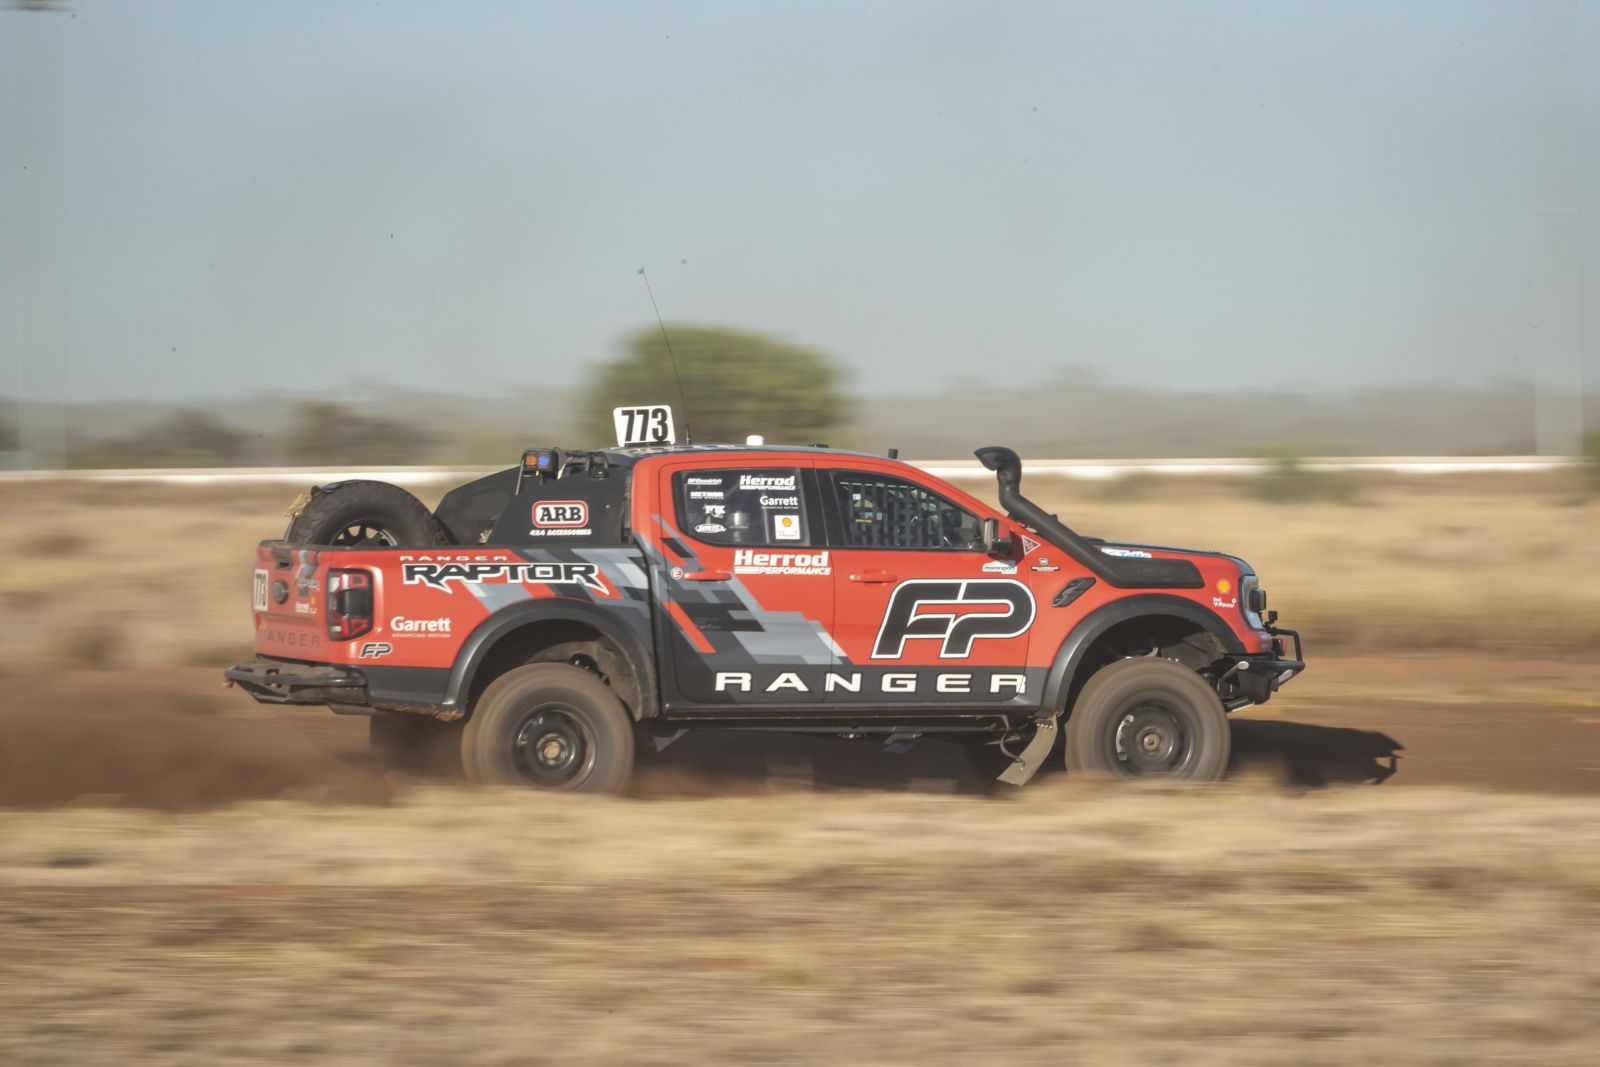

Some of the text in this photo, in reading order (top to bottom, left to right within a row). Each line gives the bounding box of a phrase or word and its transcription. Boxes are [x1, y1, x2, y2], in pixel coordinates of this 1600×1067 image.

[621, 408, 669, 442] 773
[740, 475, 796, 486] Herrod
[760, 495, 799, 506] Garrett
[540, 506, 582, 521] ARB
[546, 528, 592, 536] ACCESSORIES
[734, 550, 829, 567] Herrod
[759, 566, 832, 576] PERFORMANCE
[402, 563, 610, 596] RAPTOR
[390, 616, 452, 632] Garrett
[870, 578, 1036, 660] FP
[358, 642, 392, 659] FP
[714, 672, 1026, 694] RANGER
